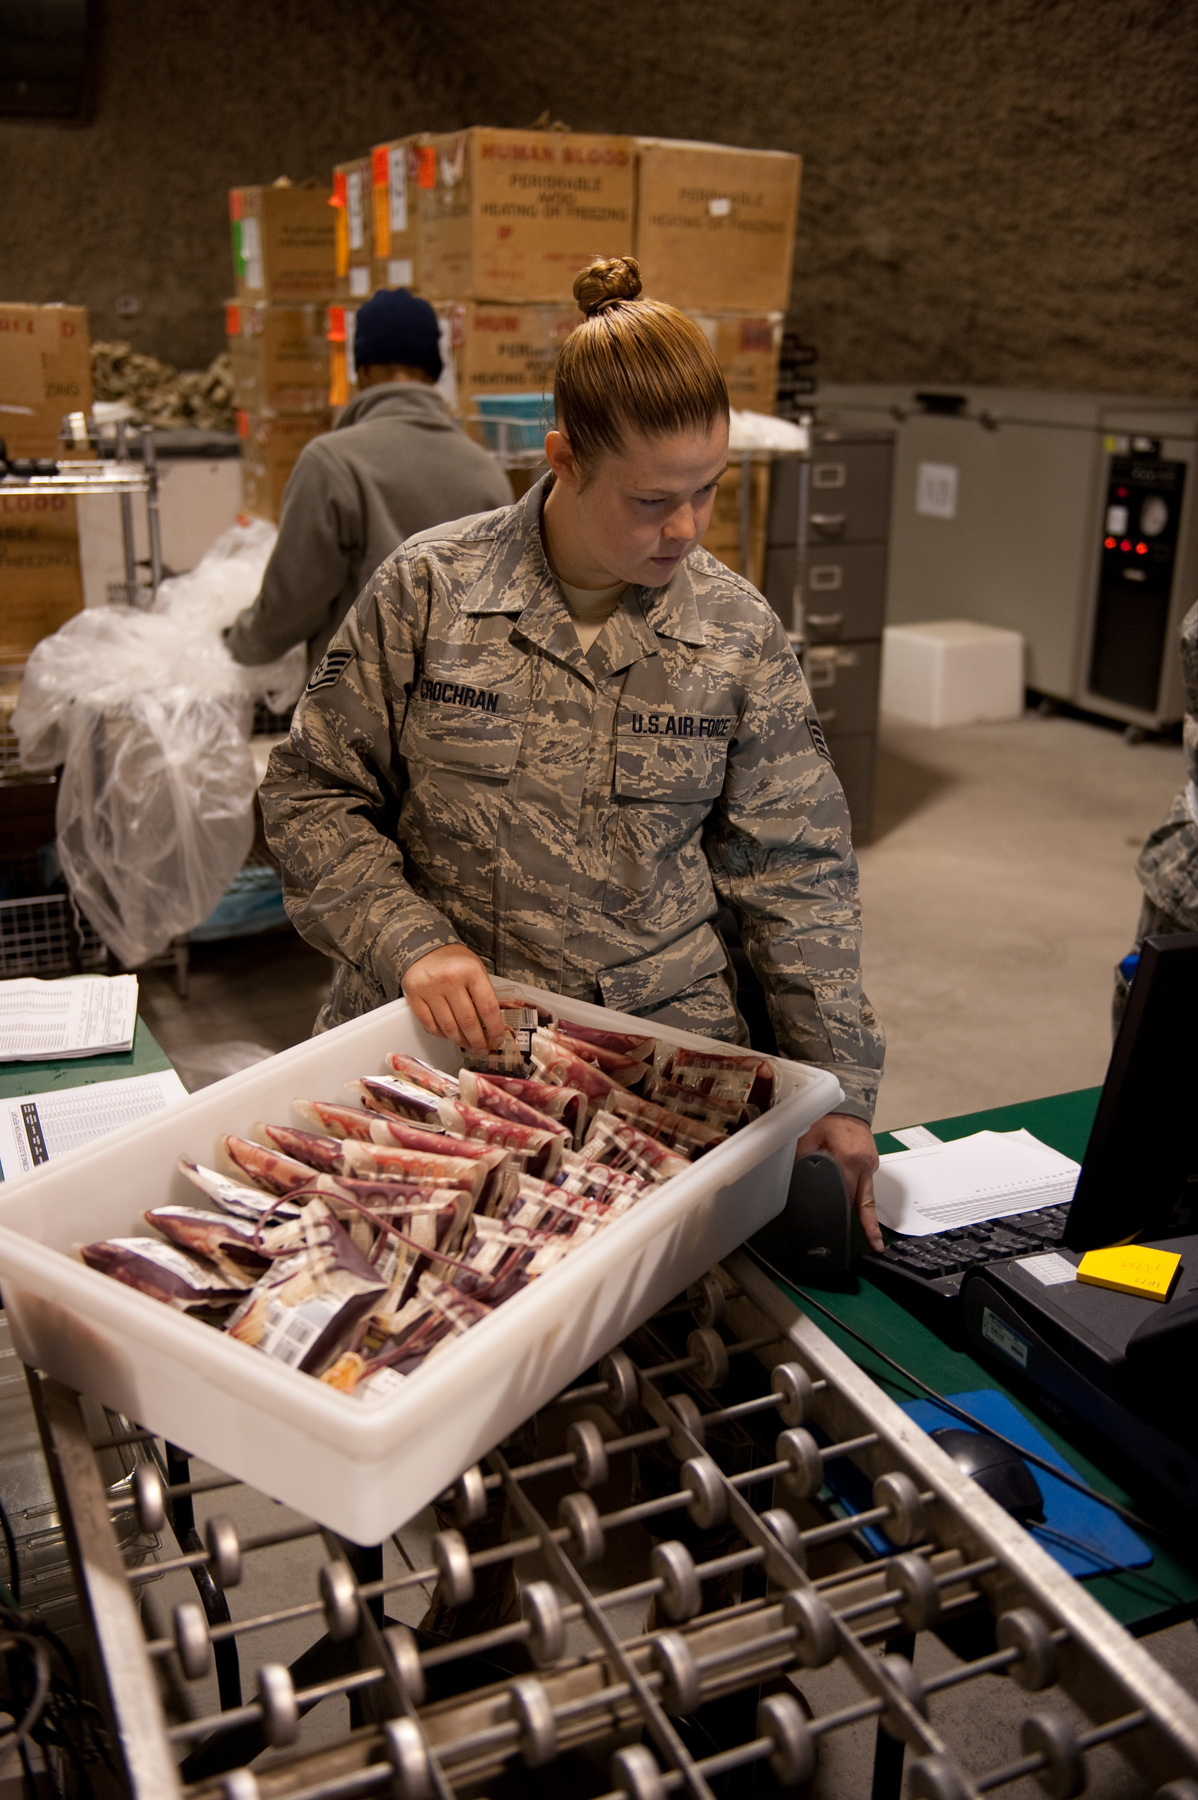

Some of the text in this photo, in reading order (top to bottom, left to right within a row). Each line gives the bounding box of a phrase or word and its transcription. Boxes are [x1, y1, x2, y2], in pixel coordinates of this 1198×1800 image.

[481, 143, 630, 166] HUMAN BLOOD
[1, 495, 66, 514] LOOD
[699, 718, 731, 737] FORCE
